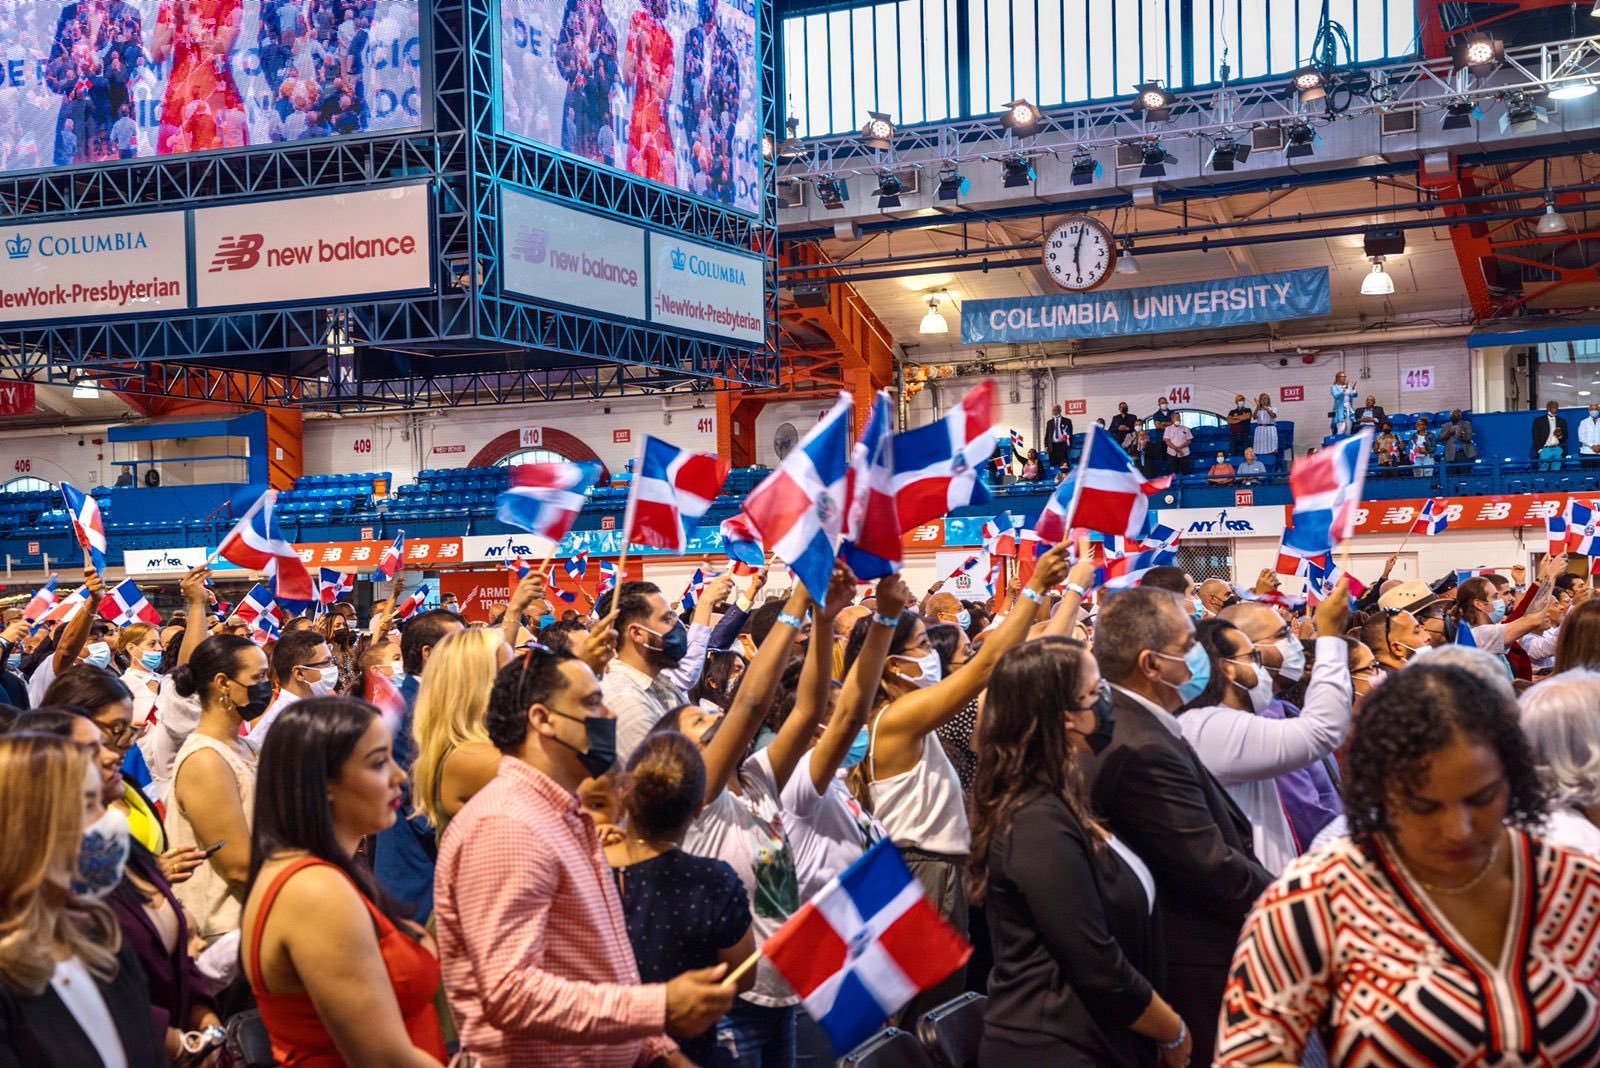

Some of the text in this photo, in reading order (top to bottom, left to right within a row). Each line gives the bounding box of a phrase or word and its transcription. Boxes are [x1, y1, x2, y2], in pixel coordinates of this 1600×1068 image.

[1070, 226, 1078, 234] 12
[38, 231, 148, 257] COLUMBIA
[1052, 240, 1062, 248] 10
[1094, 236, 1100, 244] 2
[208, 233, 264, 273] NB
[267, 235, 415, 267] new balance
[1049, 252, 1056, 262] 9
[1098, 248, 1104, 257] 3
[550, 249, 638, 287] new balance
[689, 255, 746, 286] COLUMBIA
[1055, 265, 1061, 274] 8
[1095, 261, 1101, 270] 4
[1065, 273, 1071, 281] 7
[1076, 275, 1083, 284] 6
[1089, 271, 1095, 280] 5
[990, 282, 1292, 331] COLUMBIA UNIVERSITY
[661, 295, 761, 332] NewYork-Presbyterian
[1405, 369, 1431, 388] 415
[1169, 386, 1190, 404] 414
[1283, 387, 1300, 396] EXIT
[1068, 401, 1083, 410] EXIT
[697, 417, 713, 433] 411
[522, 429, 539, 444] 410
[353, 439, 371, 453] 409
[15, 459, 31, 472] 406
[1236, 494, 1252, 505] EXIT
[602, 520, 615, 529] EXIT
[912, 525, 940, 541] NB
